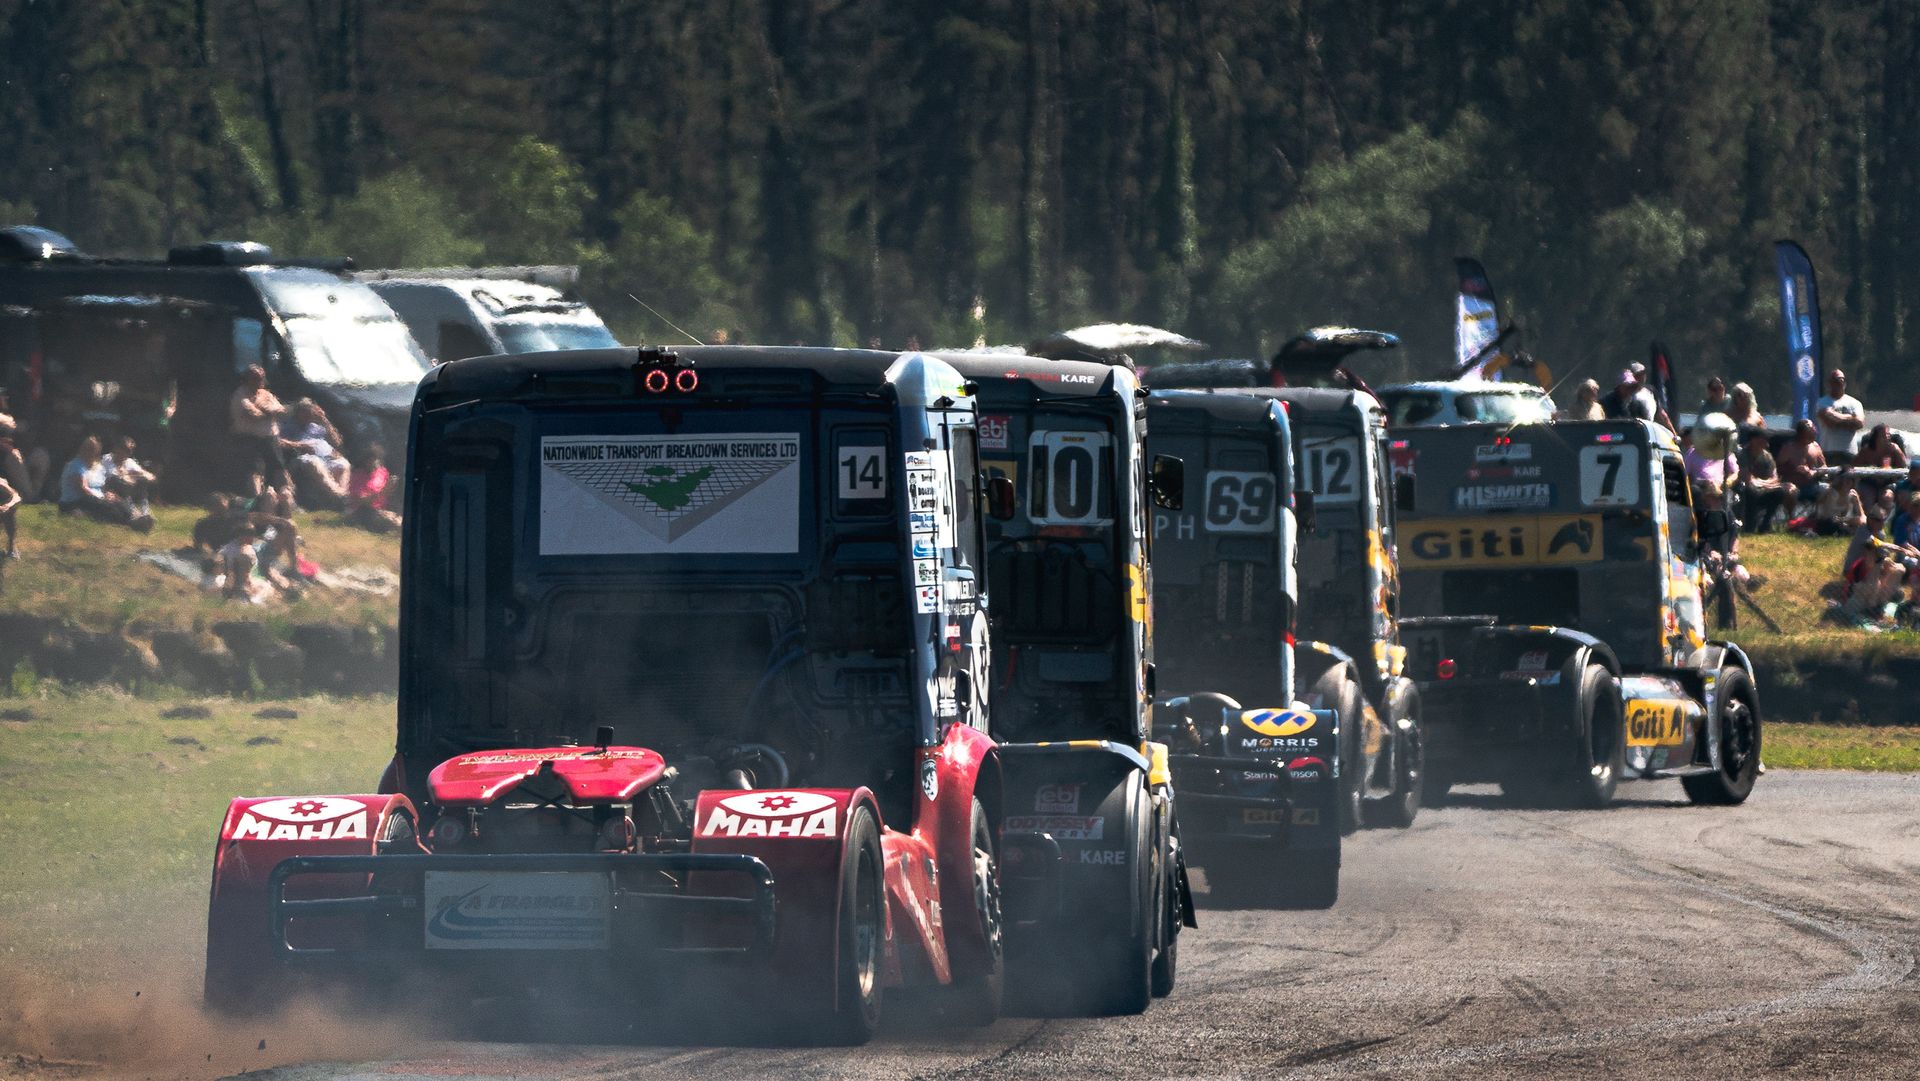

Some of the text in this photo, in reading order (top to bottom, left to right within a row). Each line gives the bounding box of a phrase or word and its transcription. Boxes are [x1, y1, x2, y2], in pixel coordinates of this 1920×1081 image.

[1061, 374, 1095, 384] KARE
[543, 443, 798, 461] NATIONWIDE TRANSPORT BREAKDOWN SERVICES LTD
[840, 455, 883, 490] 14
[1309, 448, 1353, 496] 12
[1513, 466, 1542, 478] KARE
[1596, 454, 1623, 496] 7
[1207, 476, 1275, 525] 69
[1411, 526, 1525, 560] Giti
[1630, 707, 1665, 740] Giti
[1241, 738, 1319, 747] MORRIS
[1243, 771, 1267, 780] Stan
[232, 810, 368, 840] MAHA
[702, 806, 838, 838] MAHA
[1008, 817, 1099, 830] ODYSSEY
[1080, 849, 1126, 866] KARE
